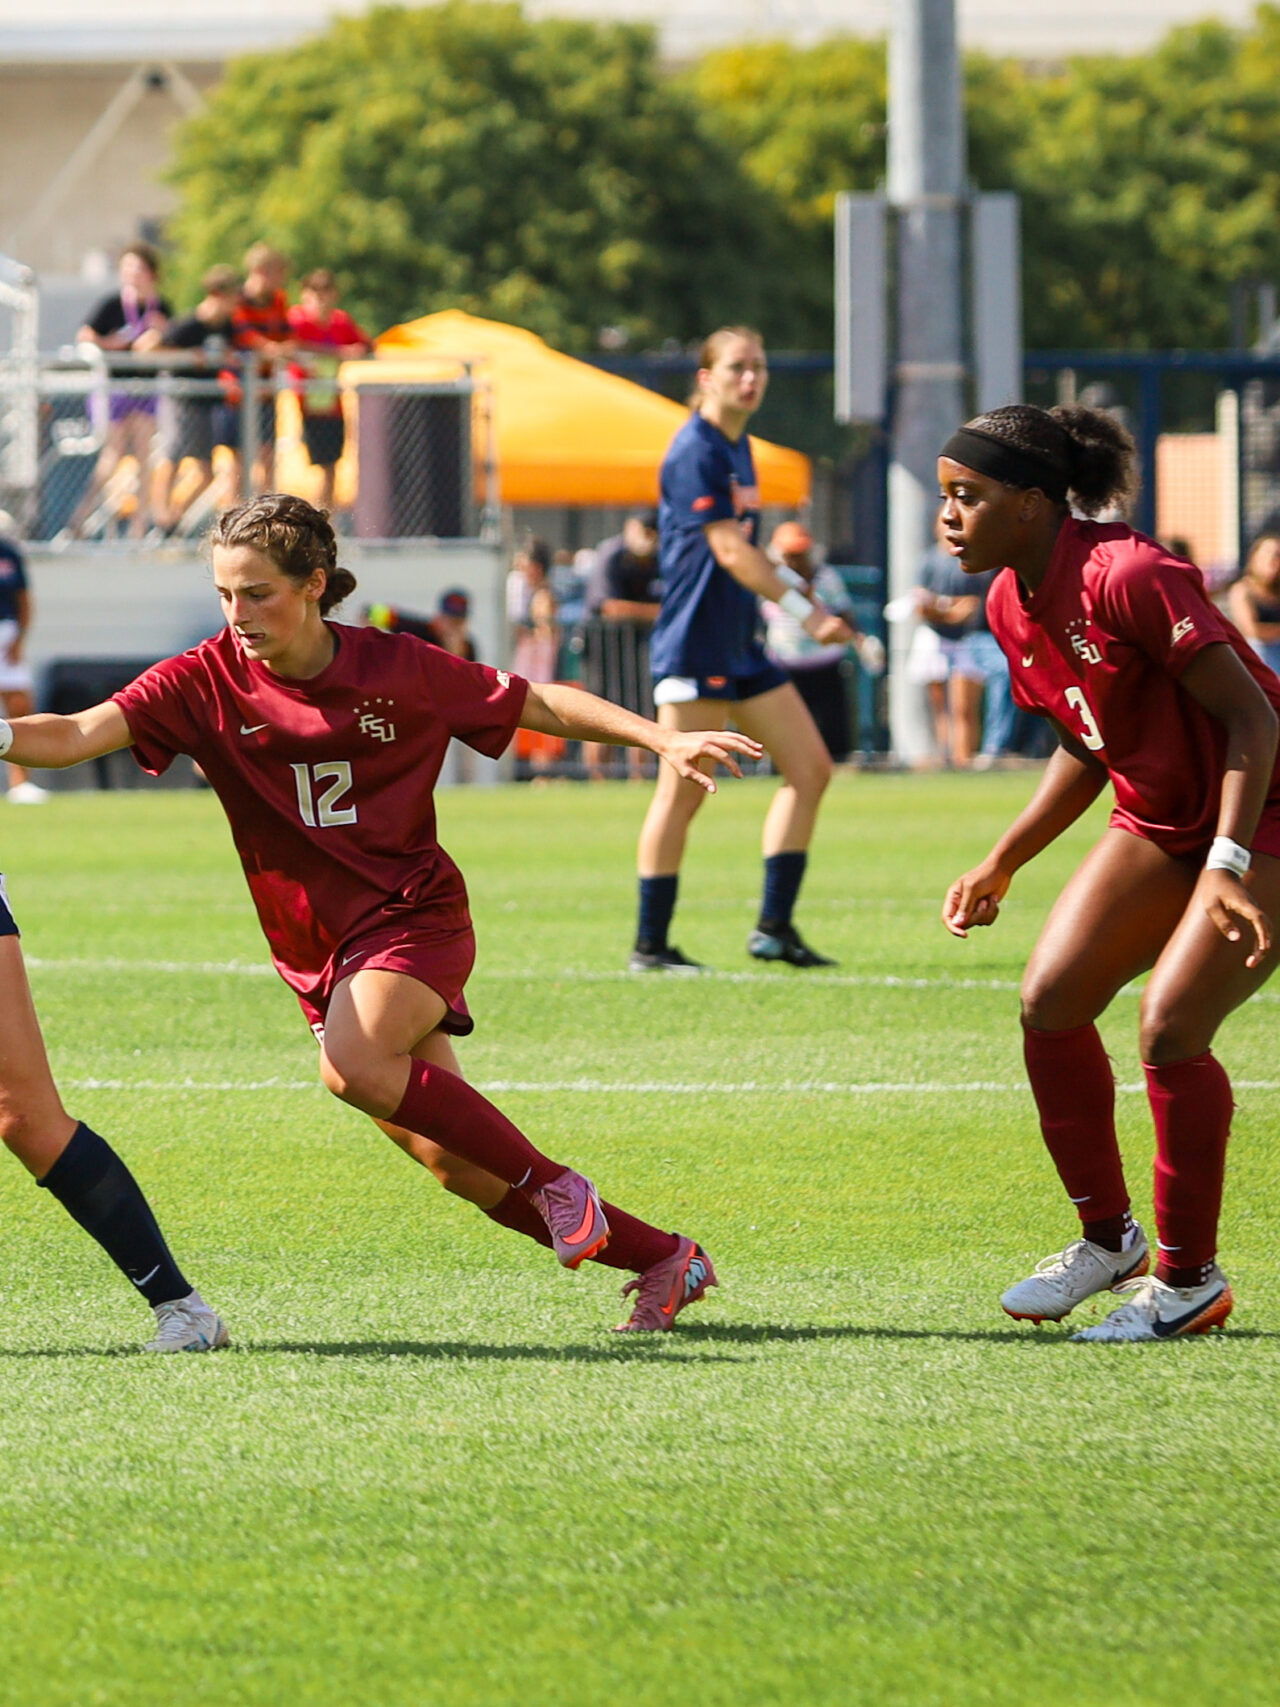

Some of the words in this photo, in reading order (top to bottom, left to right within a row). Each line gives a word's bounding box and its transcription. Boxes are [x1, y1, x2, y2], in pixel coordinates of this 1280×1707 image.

[1070, 634, 1103, 664] FSU
[359, 713, 396, 743] FSU
[1064, 686, 1106, 750] 3
[289, 760, 358, 828] 12
